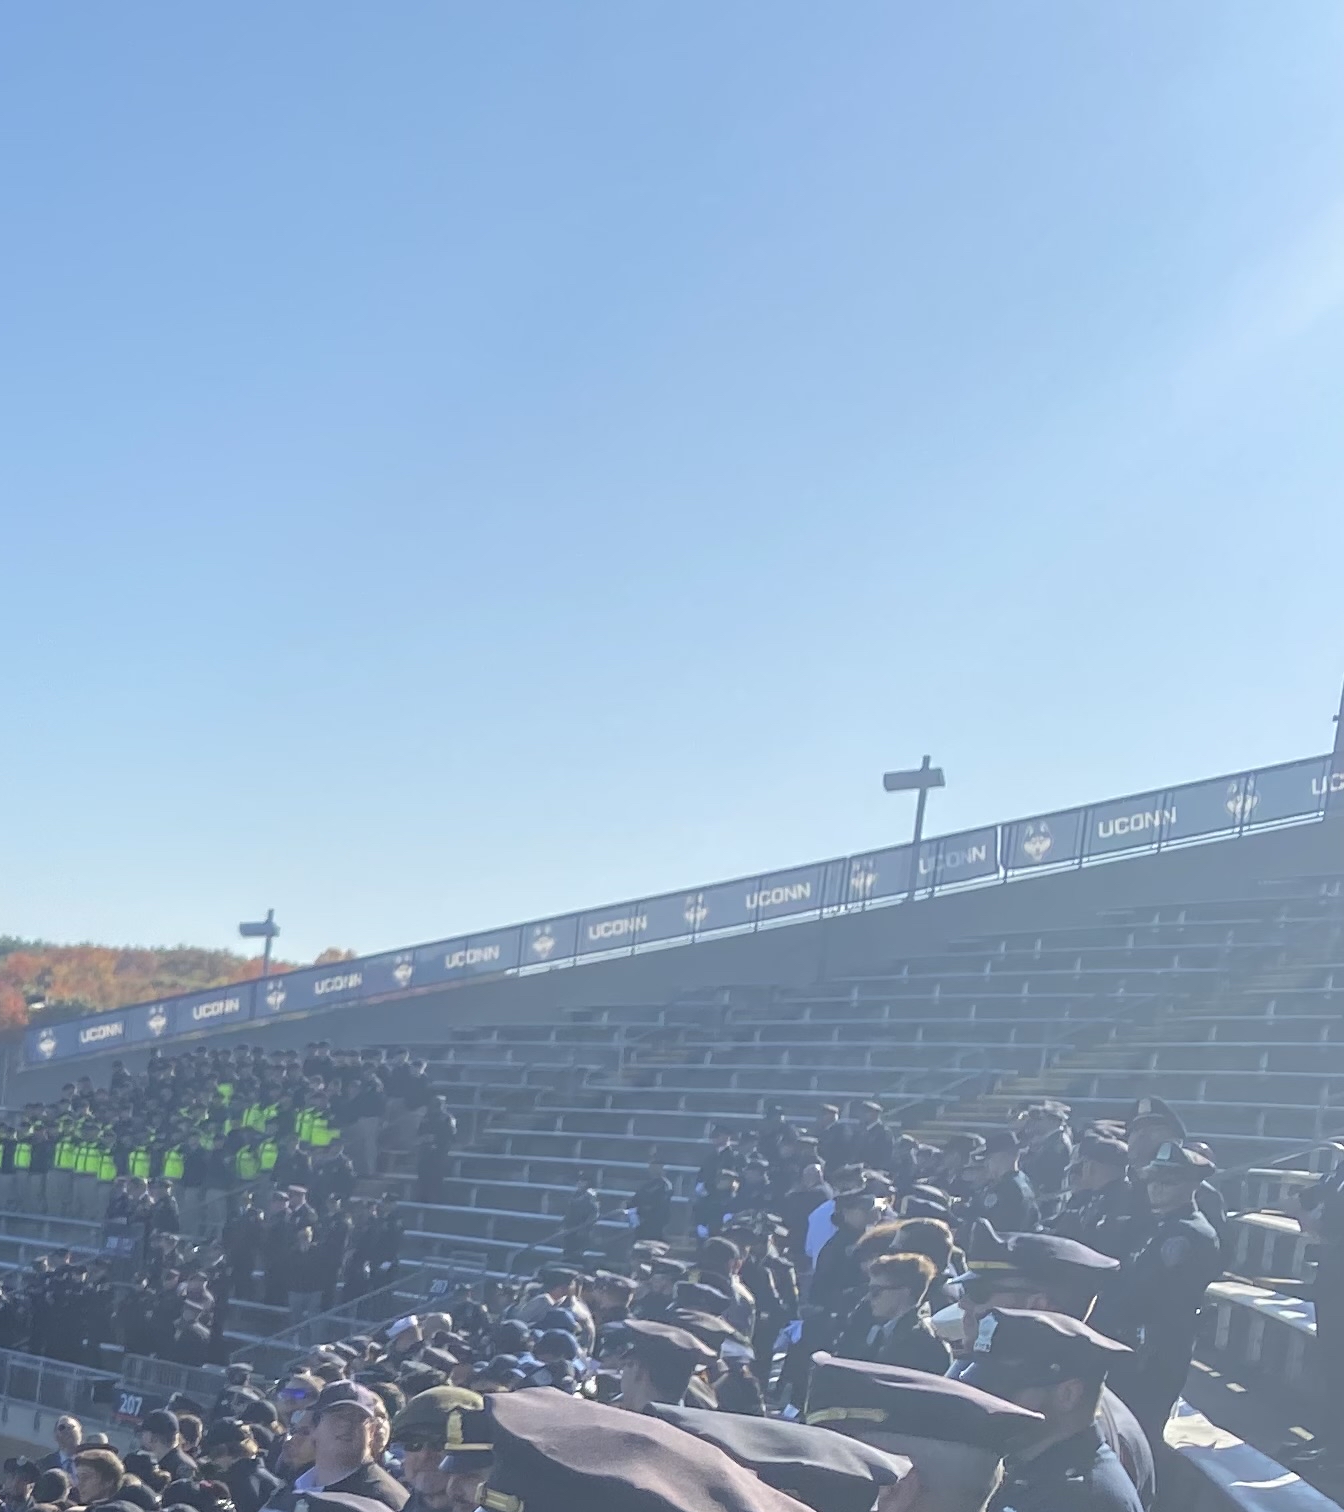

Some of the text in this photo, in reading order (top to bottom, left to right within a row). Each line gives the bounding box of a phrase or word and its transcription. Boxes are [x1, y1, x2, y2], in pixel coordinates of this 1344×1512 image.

[1098, 806, 1178, 838] UCONN
[919, 845, 987, 875] UCONN
[745, 883, 811, 909] UCONN
[588, 915, 648, 940] UCONN
[446, 945, 500, 969] UCONN
[315, 973, 362, 994] UCONN
[193, 999, 239, 1021] UCONN
[80, 1022, 122, 1043] UCONN
[119, 1393, 143, 1415] 207
